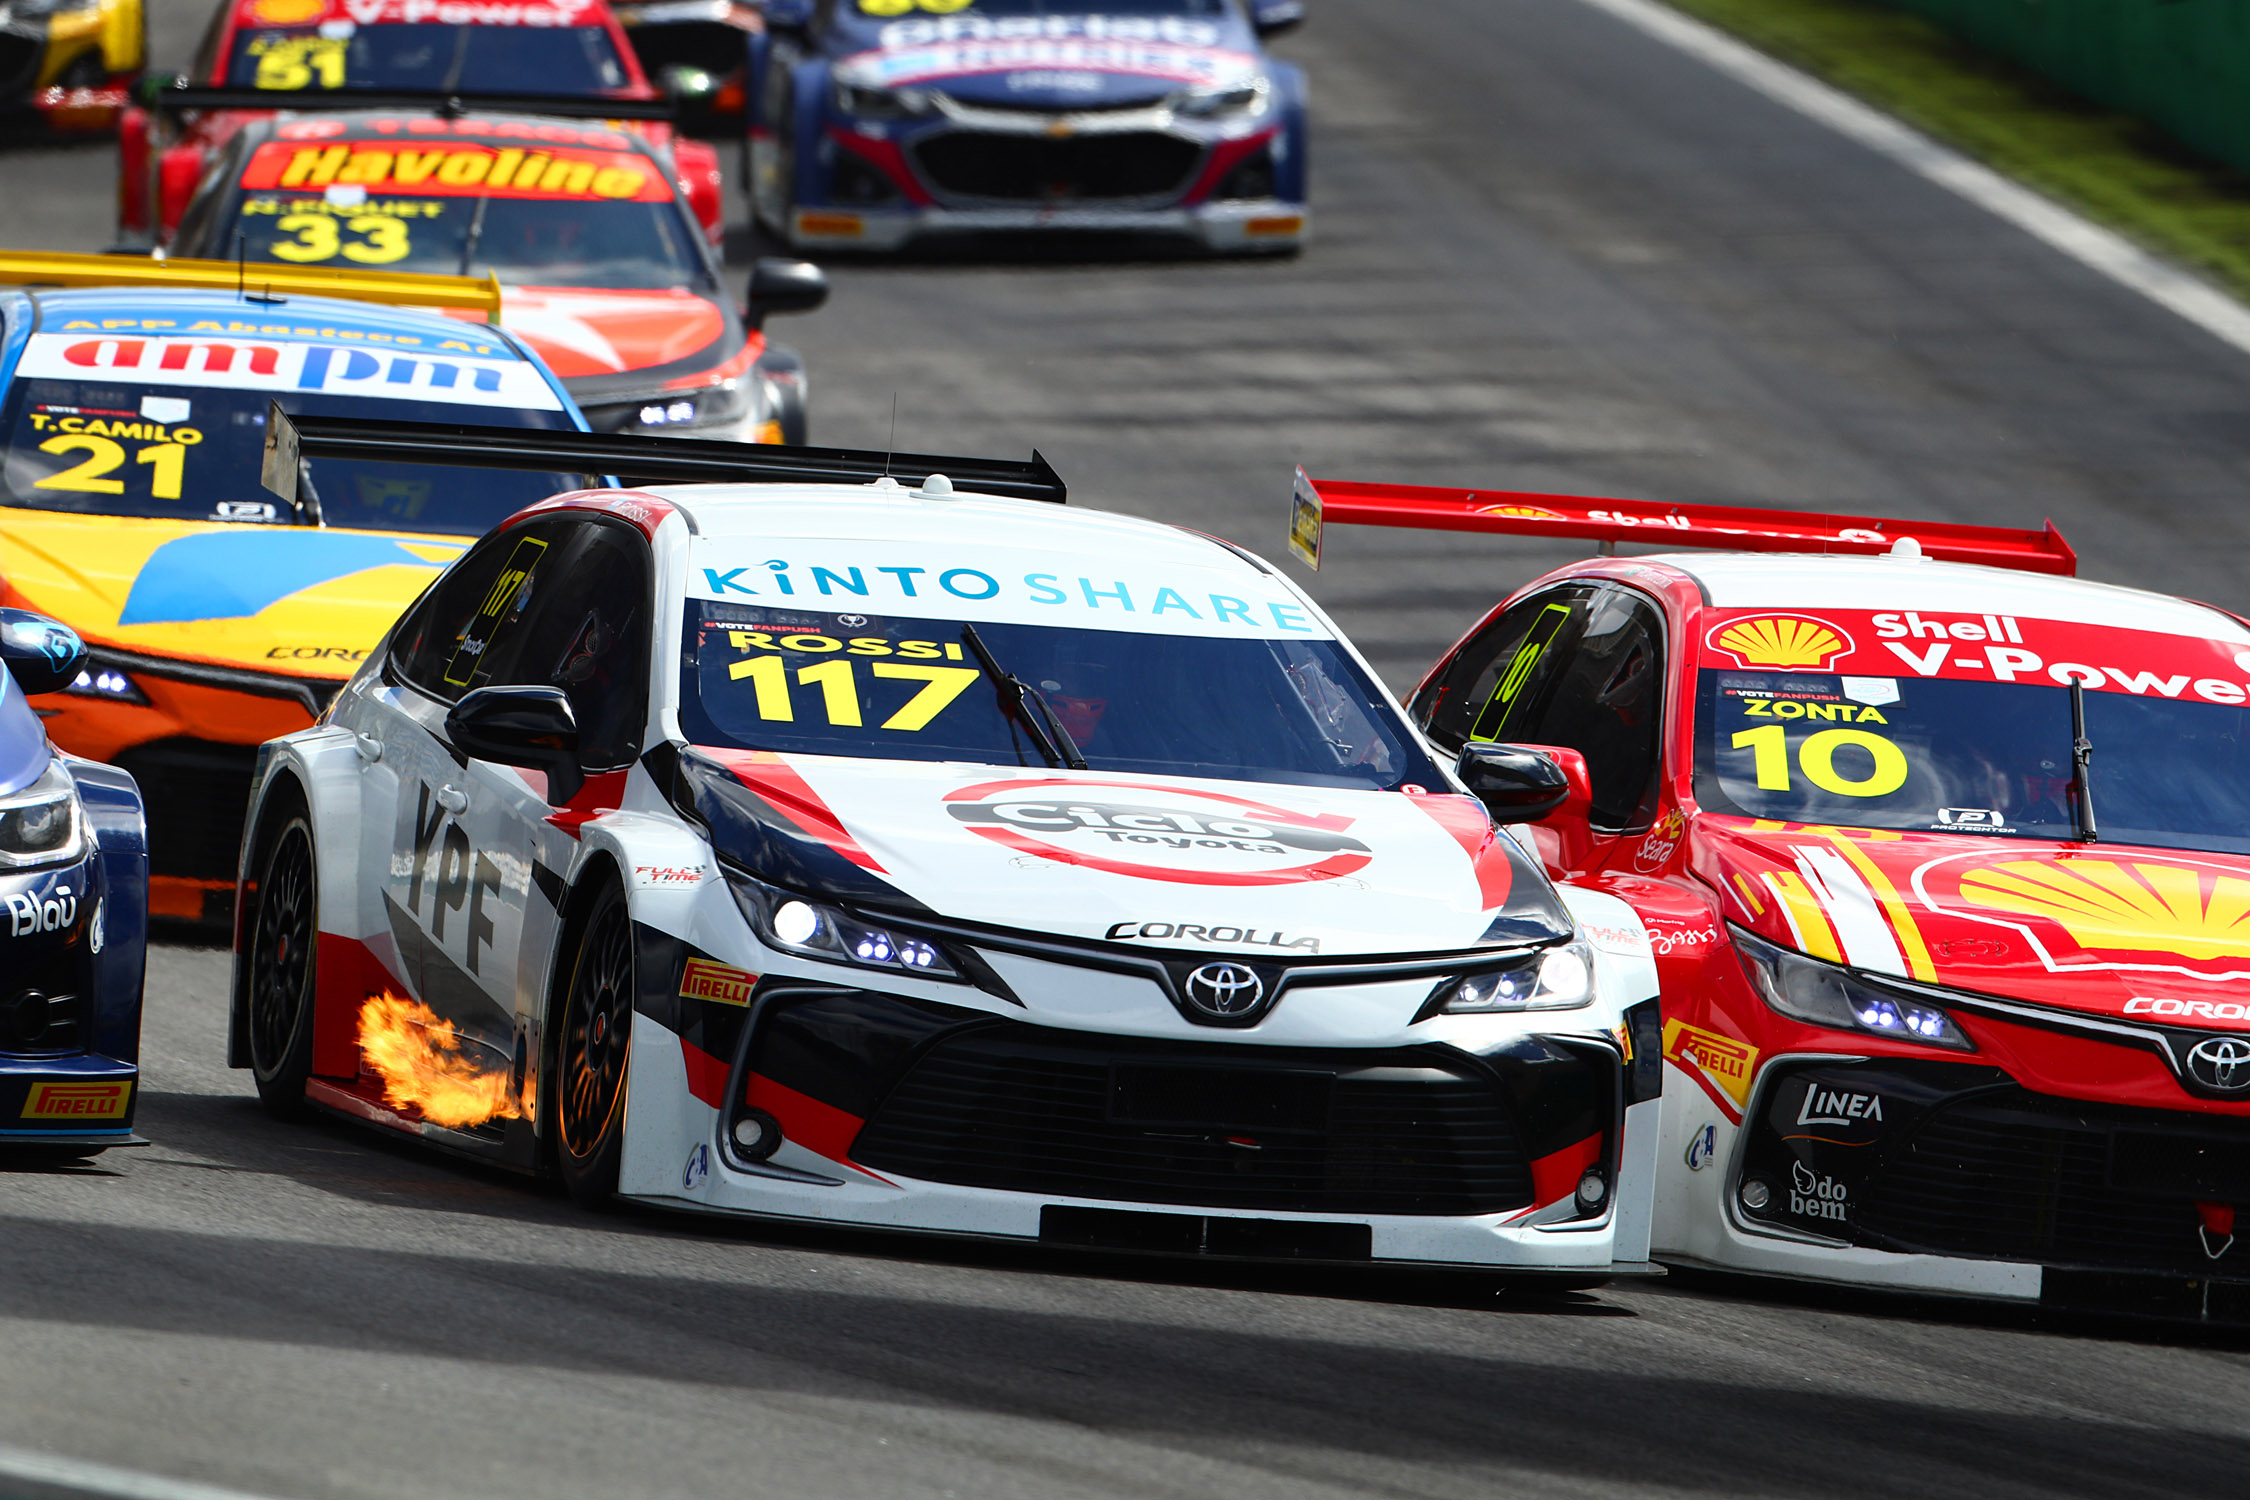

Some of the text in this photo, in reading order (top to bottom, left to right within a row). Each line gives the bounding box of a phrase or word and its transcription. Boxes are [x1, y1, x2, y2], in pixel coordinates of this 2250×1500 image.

[280, 144, 647, 198] Havoline
[269, 213, 411, 264] 33
[63, 340, 502, 392] ampm
[30, 413, 203, 444] T.CAMILO
[34, 433, 187, 499] 21
[1023, 573, 1313, 632] SHARE
[704, 622, 821, 633] #VOTEFANPUSH
[1872, 612, 2024, 643] Shell
[728, 631, 964, 660] ROSSI
[1495, 642, 1540, 703] 10
[1882, 642, 2250, 703] V-Powe
[728, 655, 981, 732] 117
[1725, 690, 1840, 701] #VOTEFANPUSH
[1743, 699, 1888, 724] ZONTA
[1731, 725, 1908, 797] 10
[993, 803, 1276, 839] Ciclo
[1930, 825, 2017, 833] PROTECHTOR
[1094, 830, 1288, 854] Toyota
[1637, 835, 1674, 862] Seara
[407, 779, 502, 978] YPF
[1105, 921, 1320, 953] COROLLA
[682, 963, 759, 1003] PIRELLI
[35, 1086, 122, 1114] PIRELLI
[1797, 1083, 1883, 1126] LINEA
[1789, 1189, 1848, 1222] bem
[1817, 1176, 1847, 1201] do
